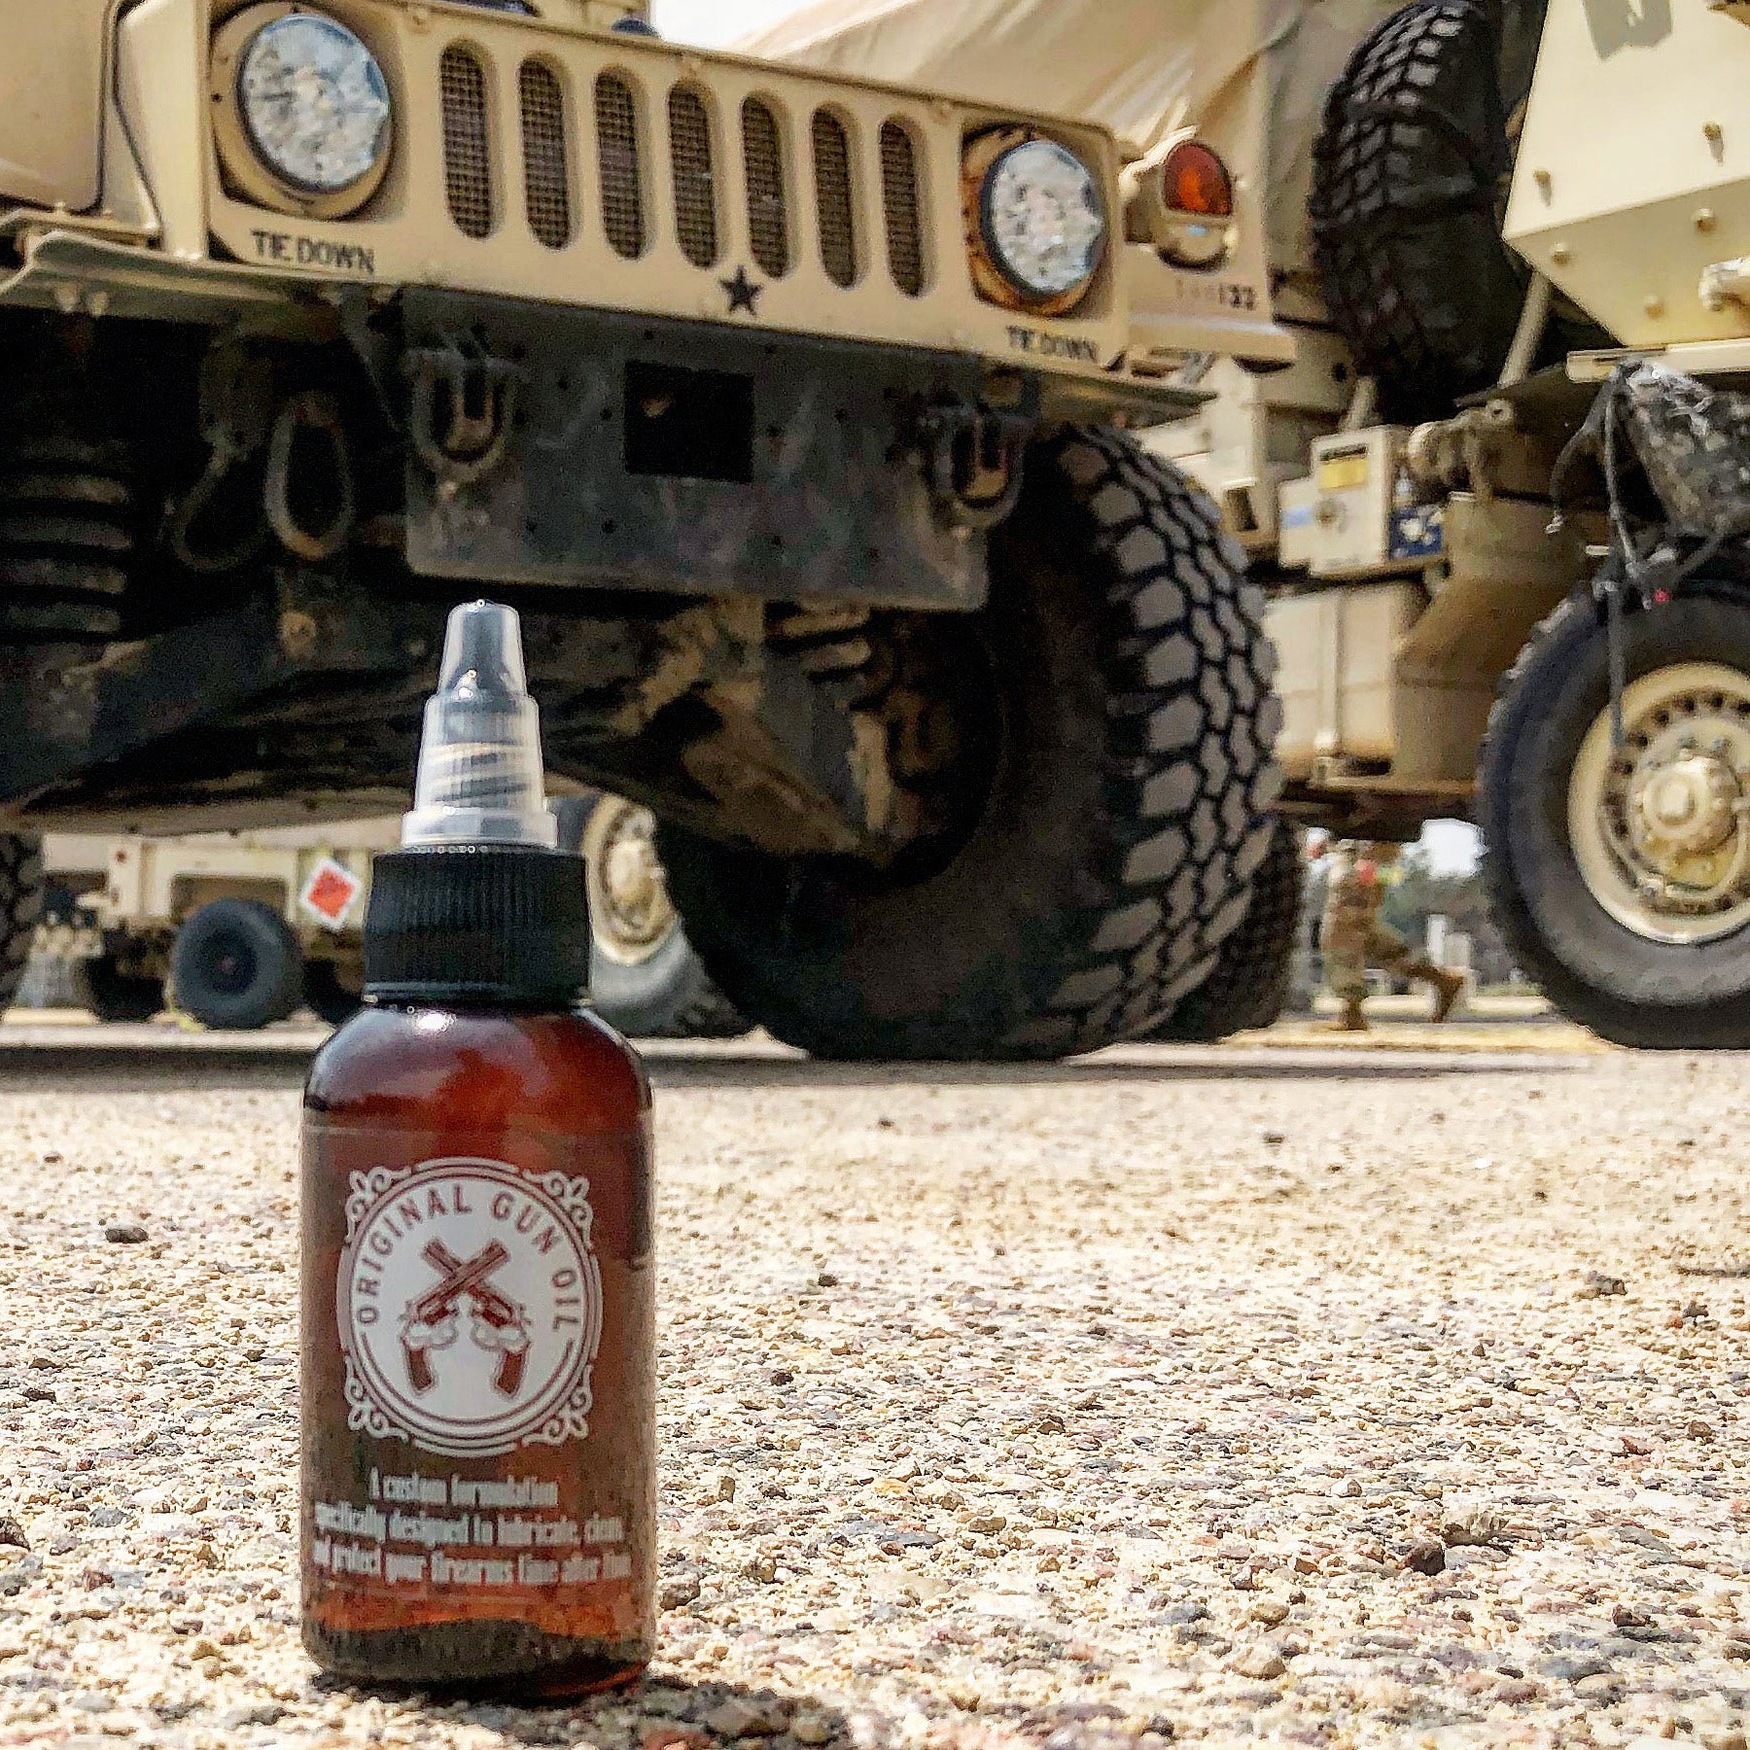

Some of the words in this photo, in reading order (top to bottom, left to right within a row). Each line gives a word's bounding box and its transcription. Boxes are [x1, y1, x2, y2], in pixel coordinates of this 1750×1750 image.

[356, 1184, 473, 1326] ORIGINAL
[490, 1191, 562, 1256] GUN
[552, 1268, 581, 1332] OIL
